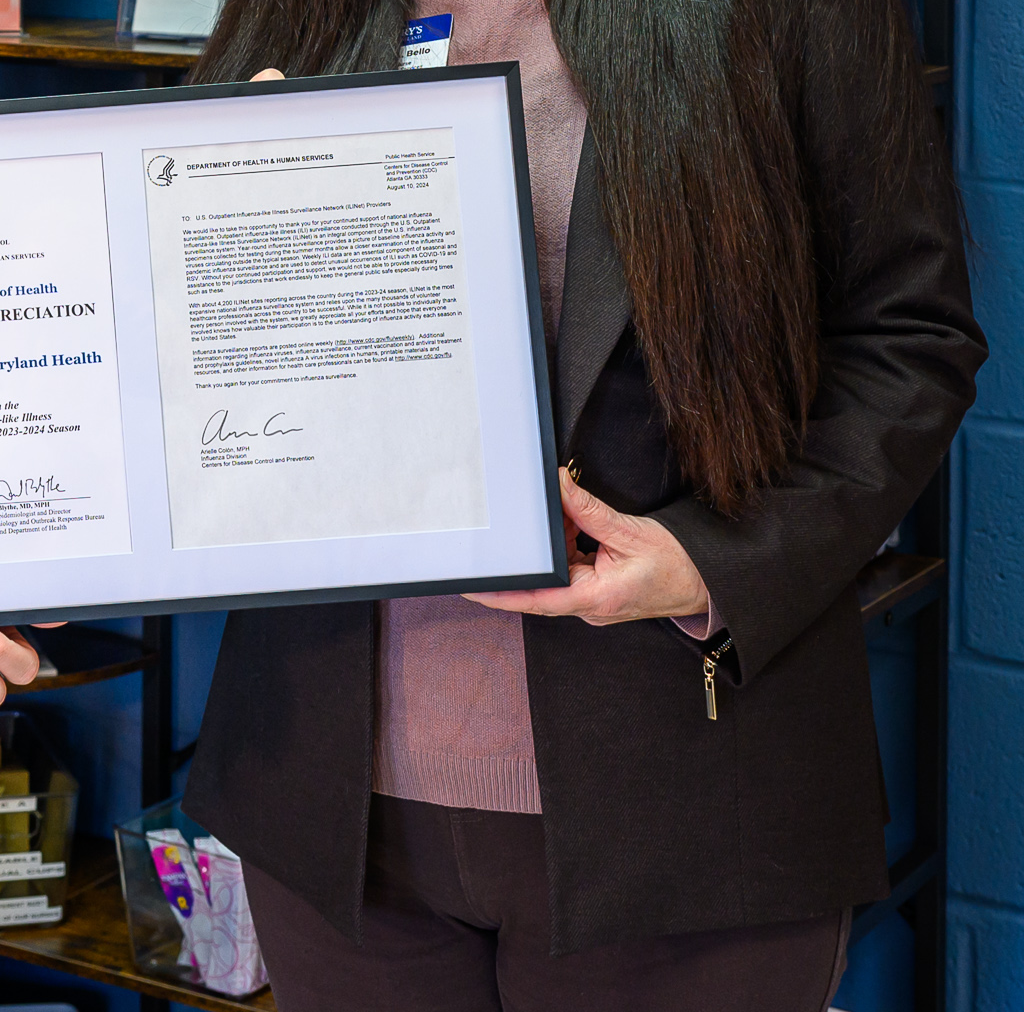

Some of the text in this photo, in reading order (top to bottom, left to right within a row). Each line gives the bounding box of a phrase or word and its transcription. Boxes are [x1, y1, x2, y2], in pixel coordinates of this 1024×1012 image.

[407, 47, 431, 57] Bello
[186, 161, 231, 170] DEPARTMENT
[242, 158, 269, 166] HEALTH
[276, 156, 300, 164] HUMAN
[301, 154, 334, 162] SERVICES
[11, 252, 45, 260] SERVICES
[0, 285, 13, 297] of
[15, 283, 58, 296] Health
[52, 351, 102, 366] Health
[260, 377, 293, 385] commitment
[4, 401, 19, 410] the
[22, 412, 52, 422] Illness
[47, 424, 81, 433] Season
[30, 517, 56, 525] Outbreak
[8, 527, 40, 535] Department
